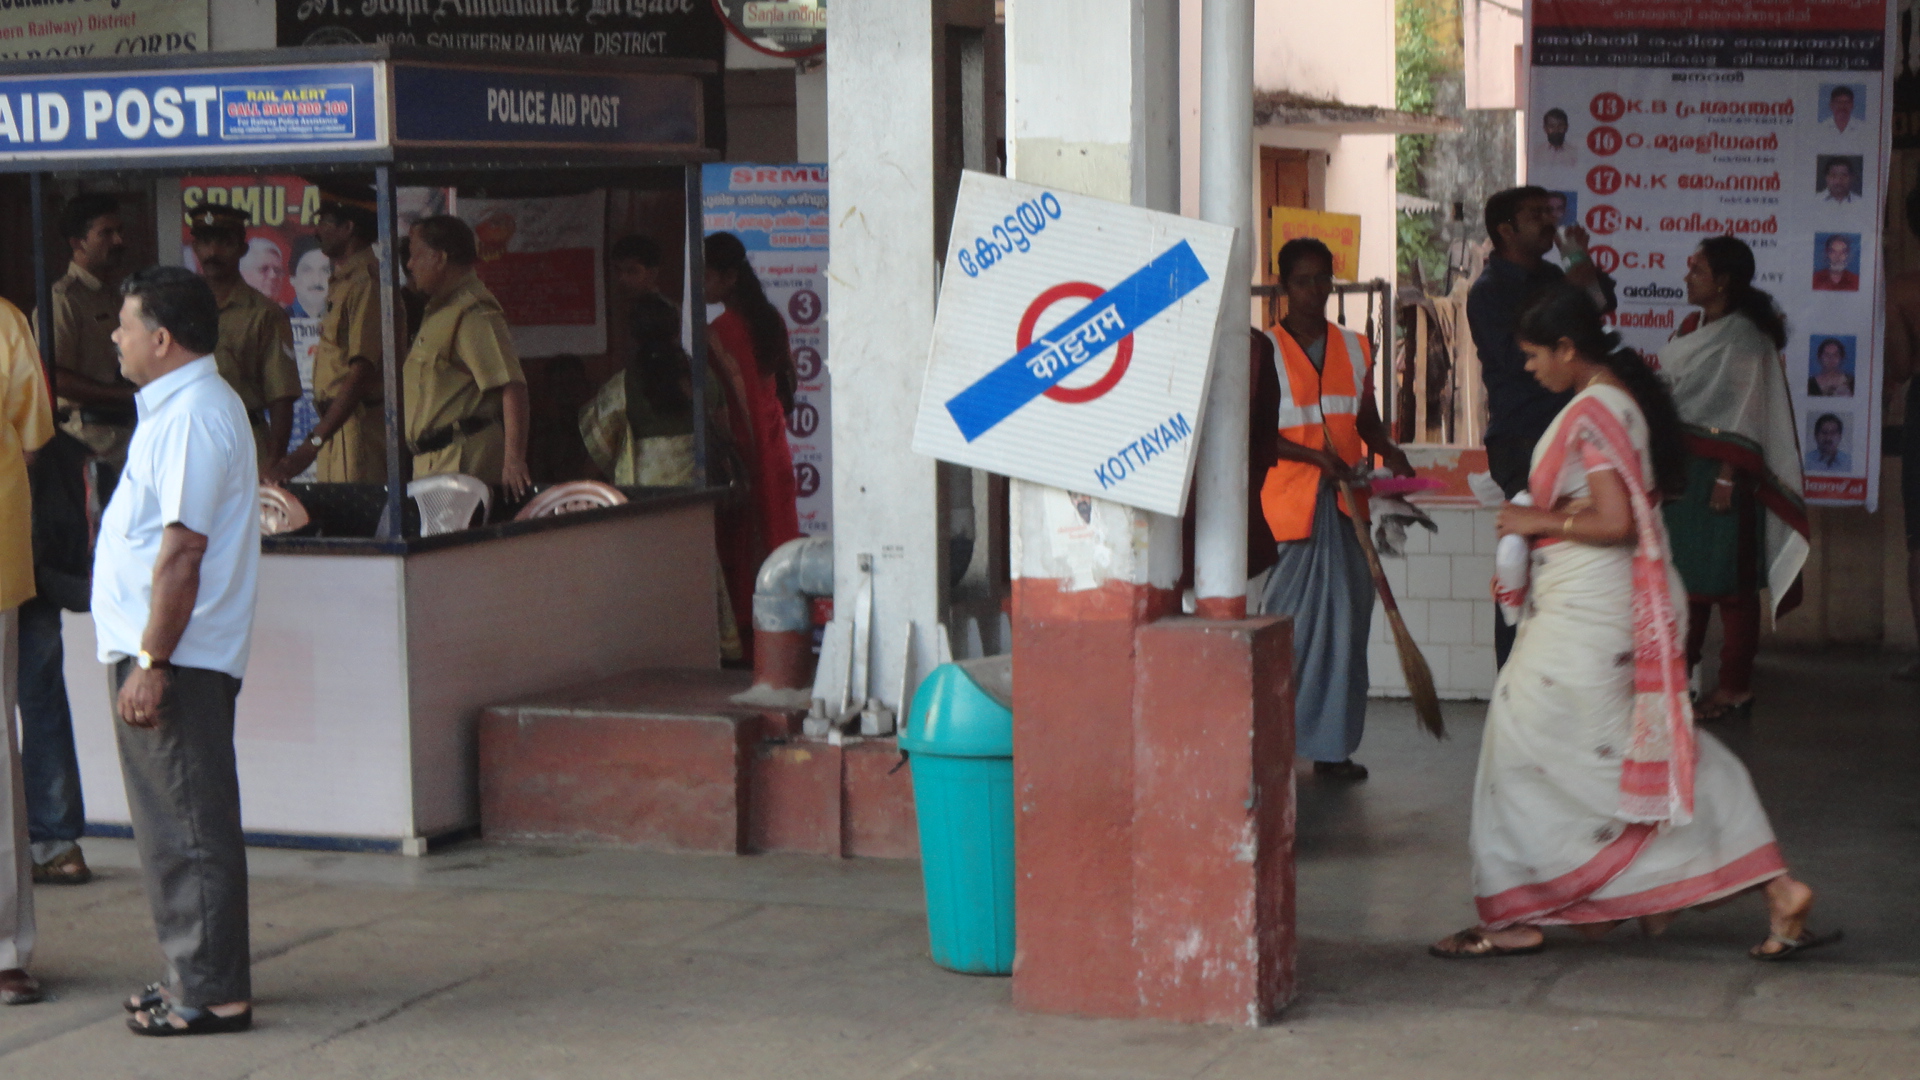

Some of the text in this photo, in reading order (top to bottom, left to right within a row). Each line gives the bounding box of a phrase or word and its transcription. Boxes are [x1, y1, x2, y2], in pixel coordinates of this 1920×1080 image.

[88, 11, 137, 31] District
[246, 89, 328, 103] RAIL ALERT
[487, 88, 620, 127] POLICE AID POST
[0, 86, 217, 143] AID POST
[227, 102, 261, 118] CALL
[1594, 171, 1616, 191] 17
[1625, 173, 1668, 189] N.K
[958, 192, 1062, 278] കോട്ടയം
[1623, 252, 1666, 269] C.R
[797, 294, 813, 320] 3
[1026, 303, 1125, 380] कोट्टयम
[796, 351, 812, 375] 5
[793, 403, 813, 426] 10
[1094, 412, 1192, 490] KOTTAYAM
